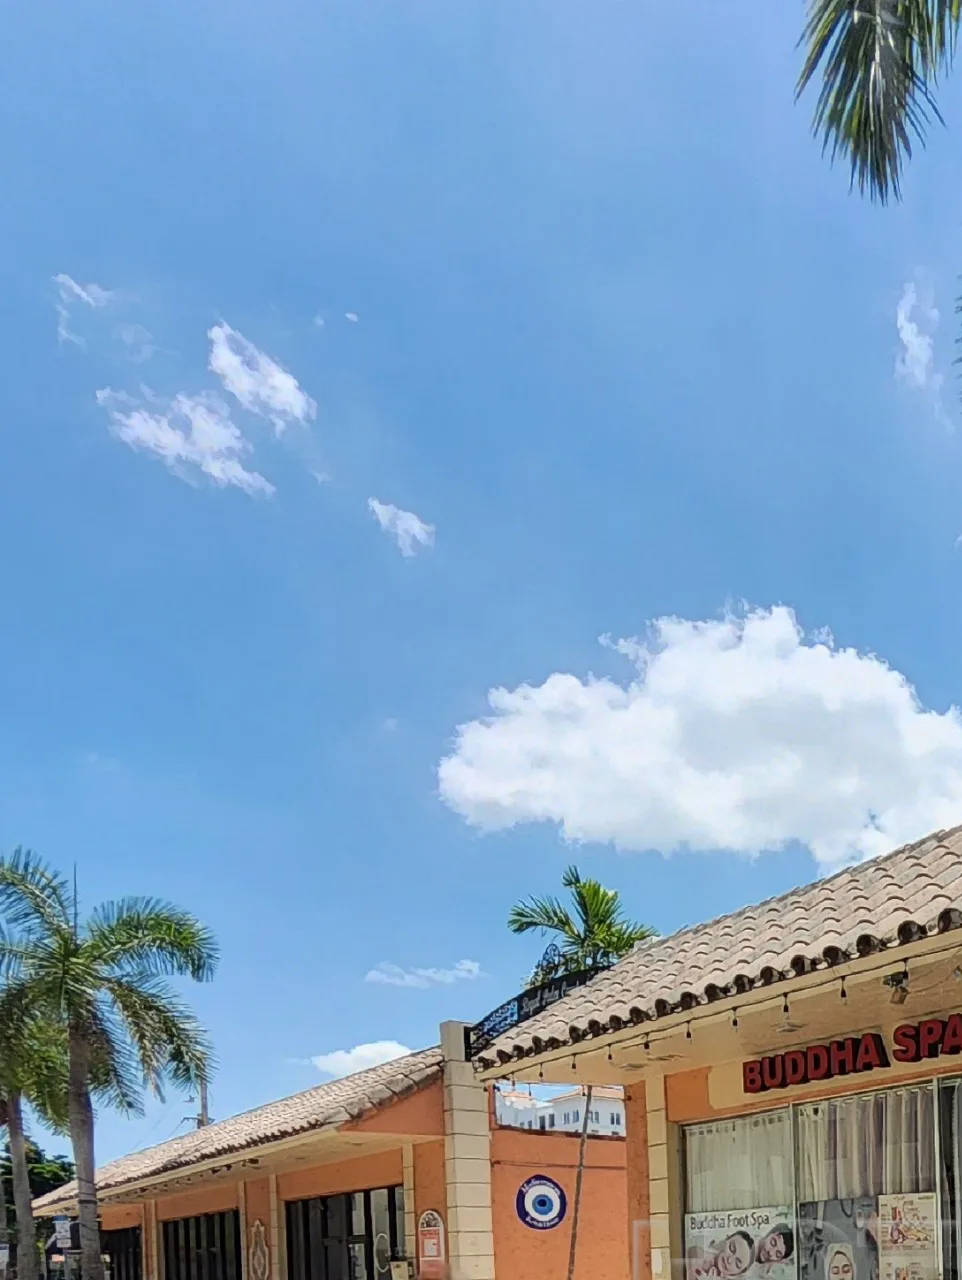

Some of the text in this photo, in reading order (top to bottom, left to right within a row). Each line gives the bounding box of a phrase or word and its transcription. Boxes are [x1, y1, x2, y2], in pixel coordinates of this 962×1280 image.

[743, 1033, 891, 1093] BUDDHA
[690, 1212, 769, 1230] Buddha Foot Spa
